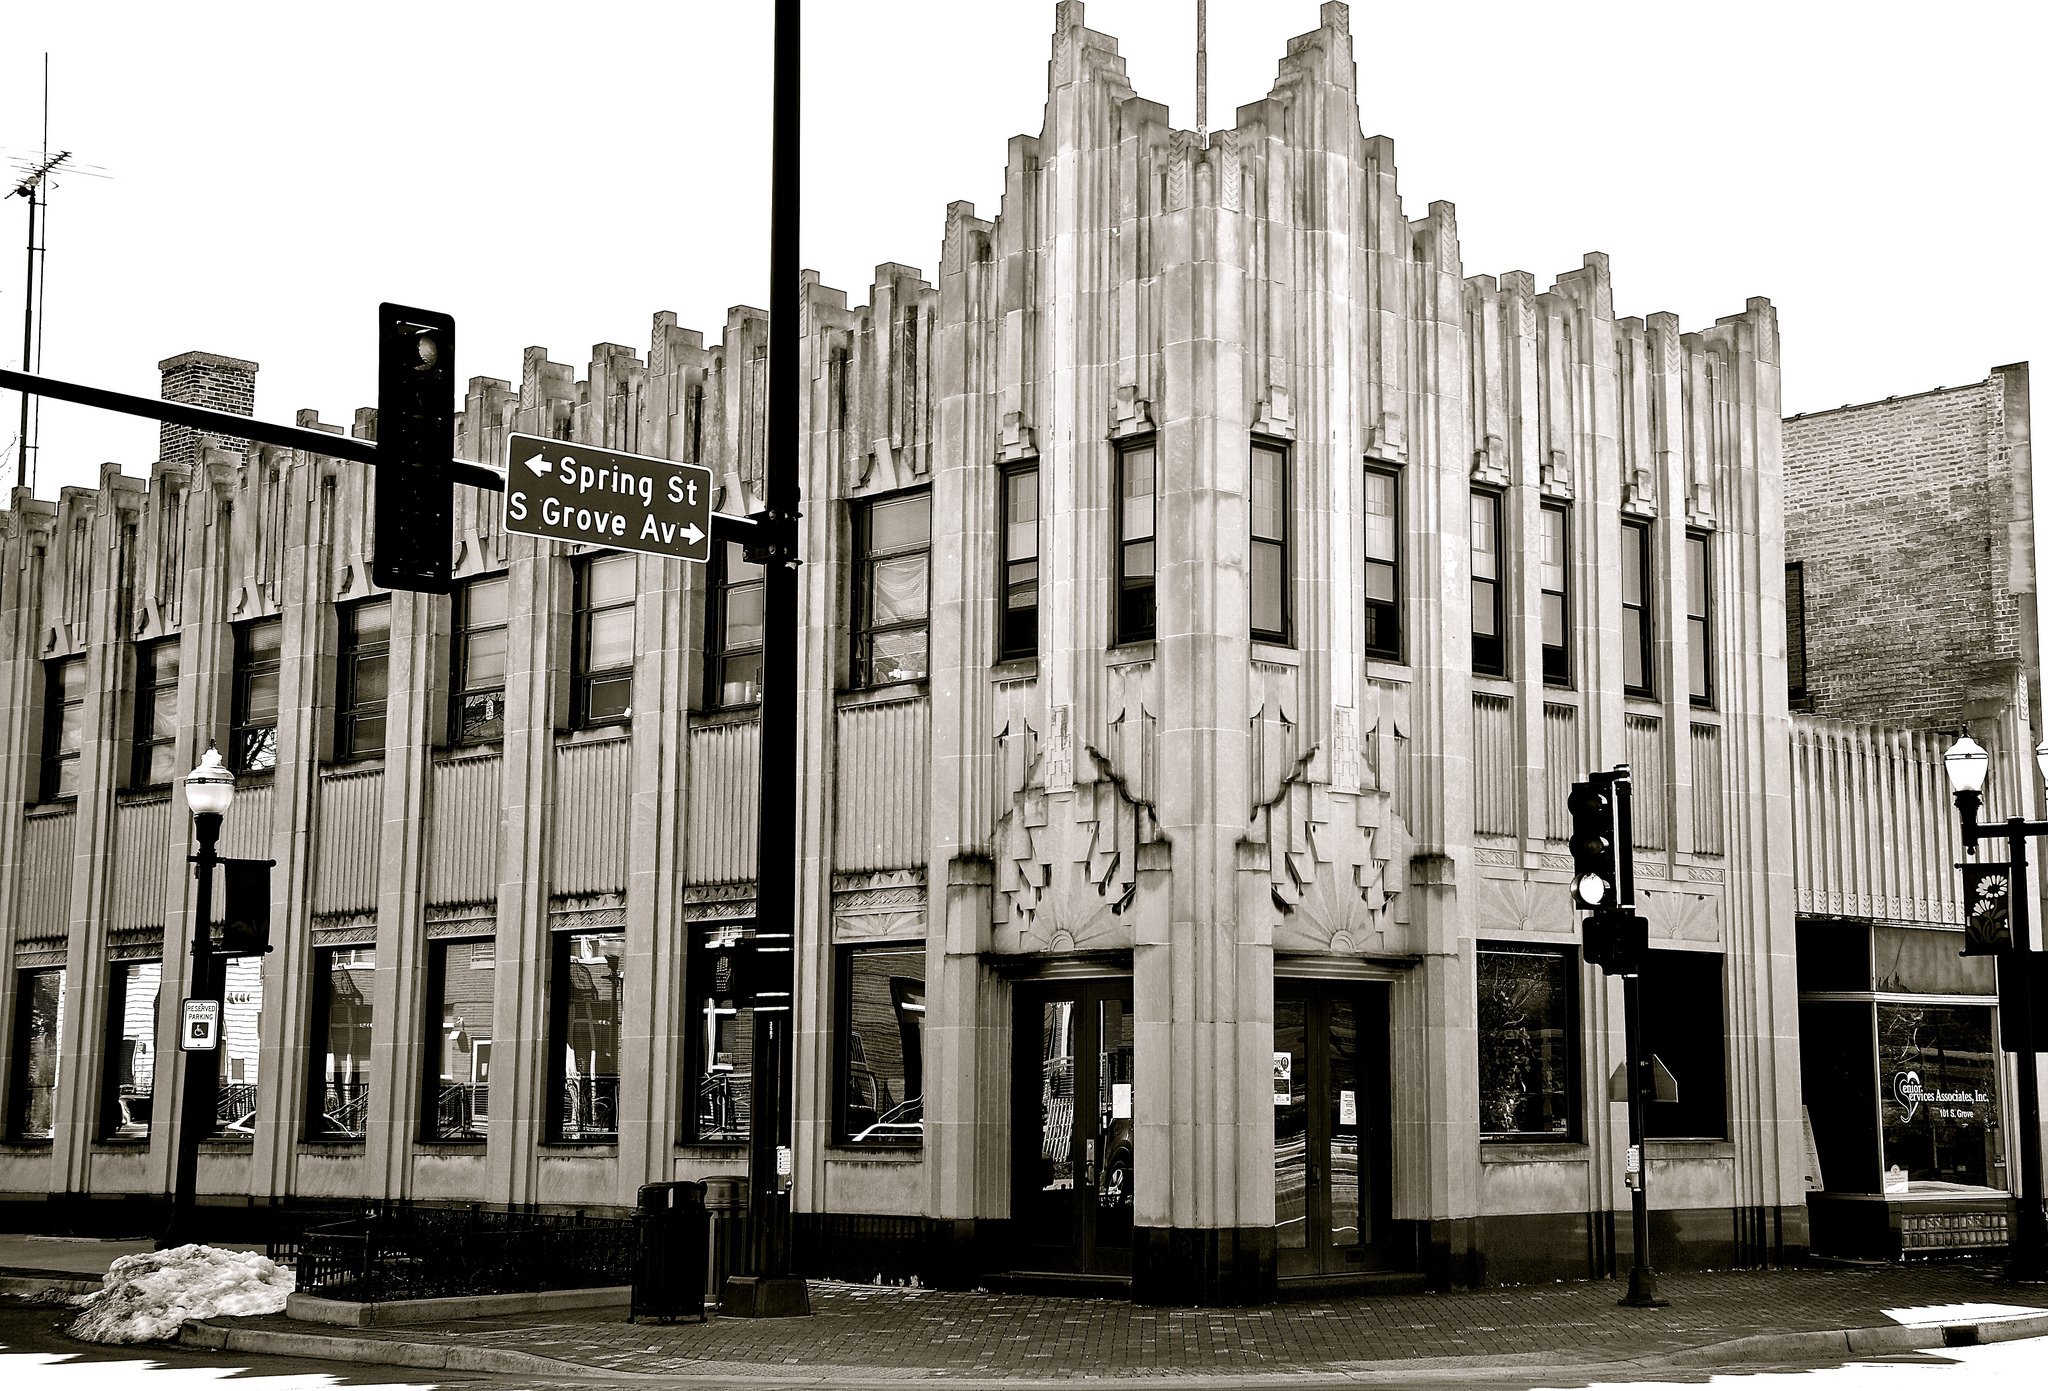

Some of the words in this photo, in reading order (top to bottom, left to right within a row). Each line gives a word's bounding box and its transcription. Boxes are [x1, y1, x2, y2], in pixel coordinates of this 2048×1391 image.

[559, 456, 653, 507] Spring
[667, 475, 698, 506] St
[509, 491, 528, 520] S
[542, 497, 626, 536] Grove
[639, 513, 676, 544] Av
[1939, 1108, 1949, 1118] 101
[1956, 1108, 1974, 1118] Grove
